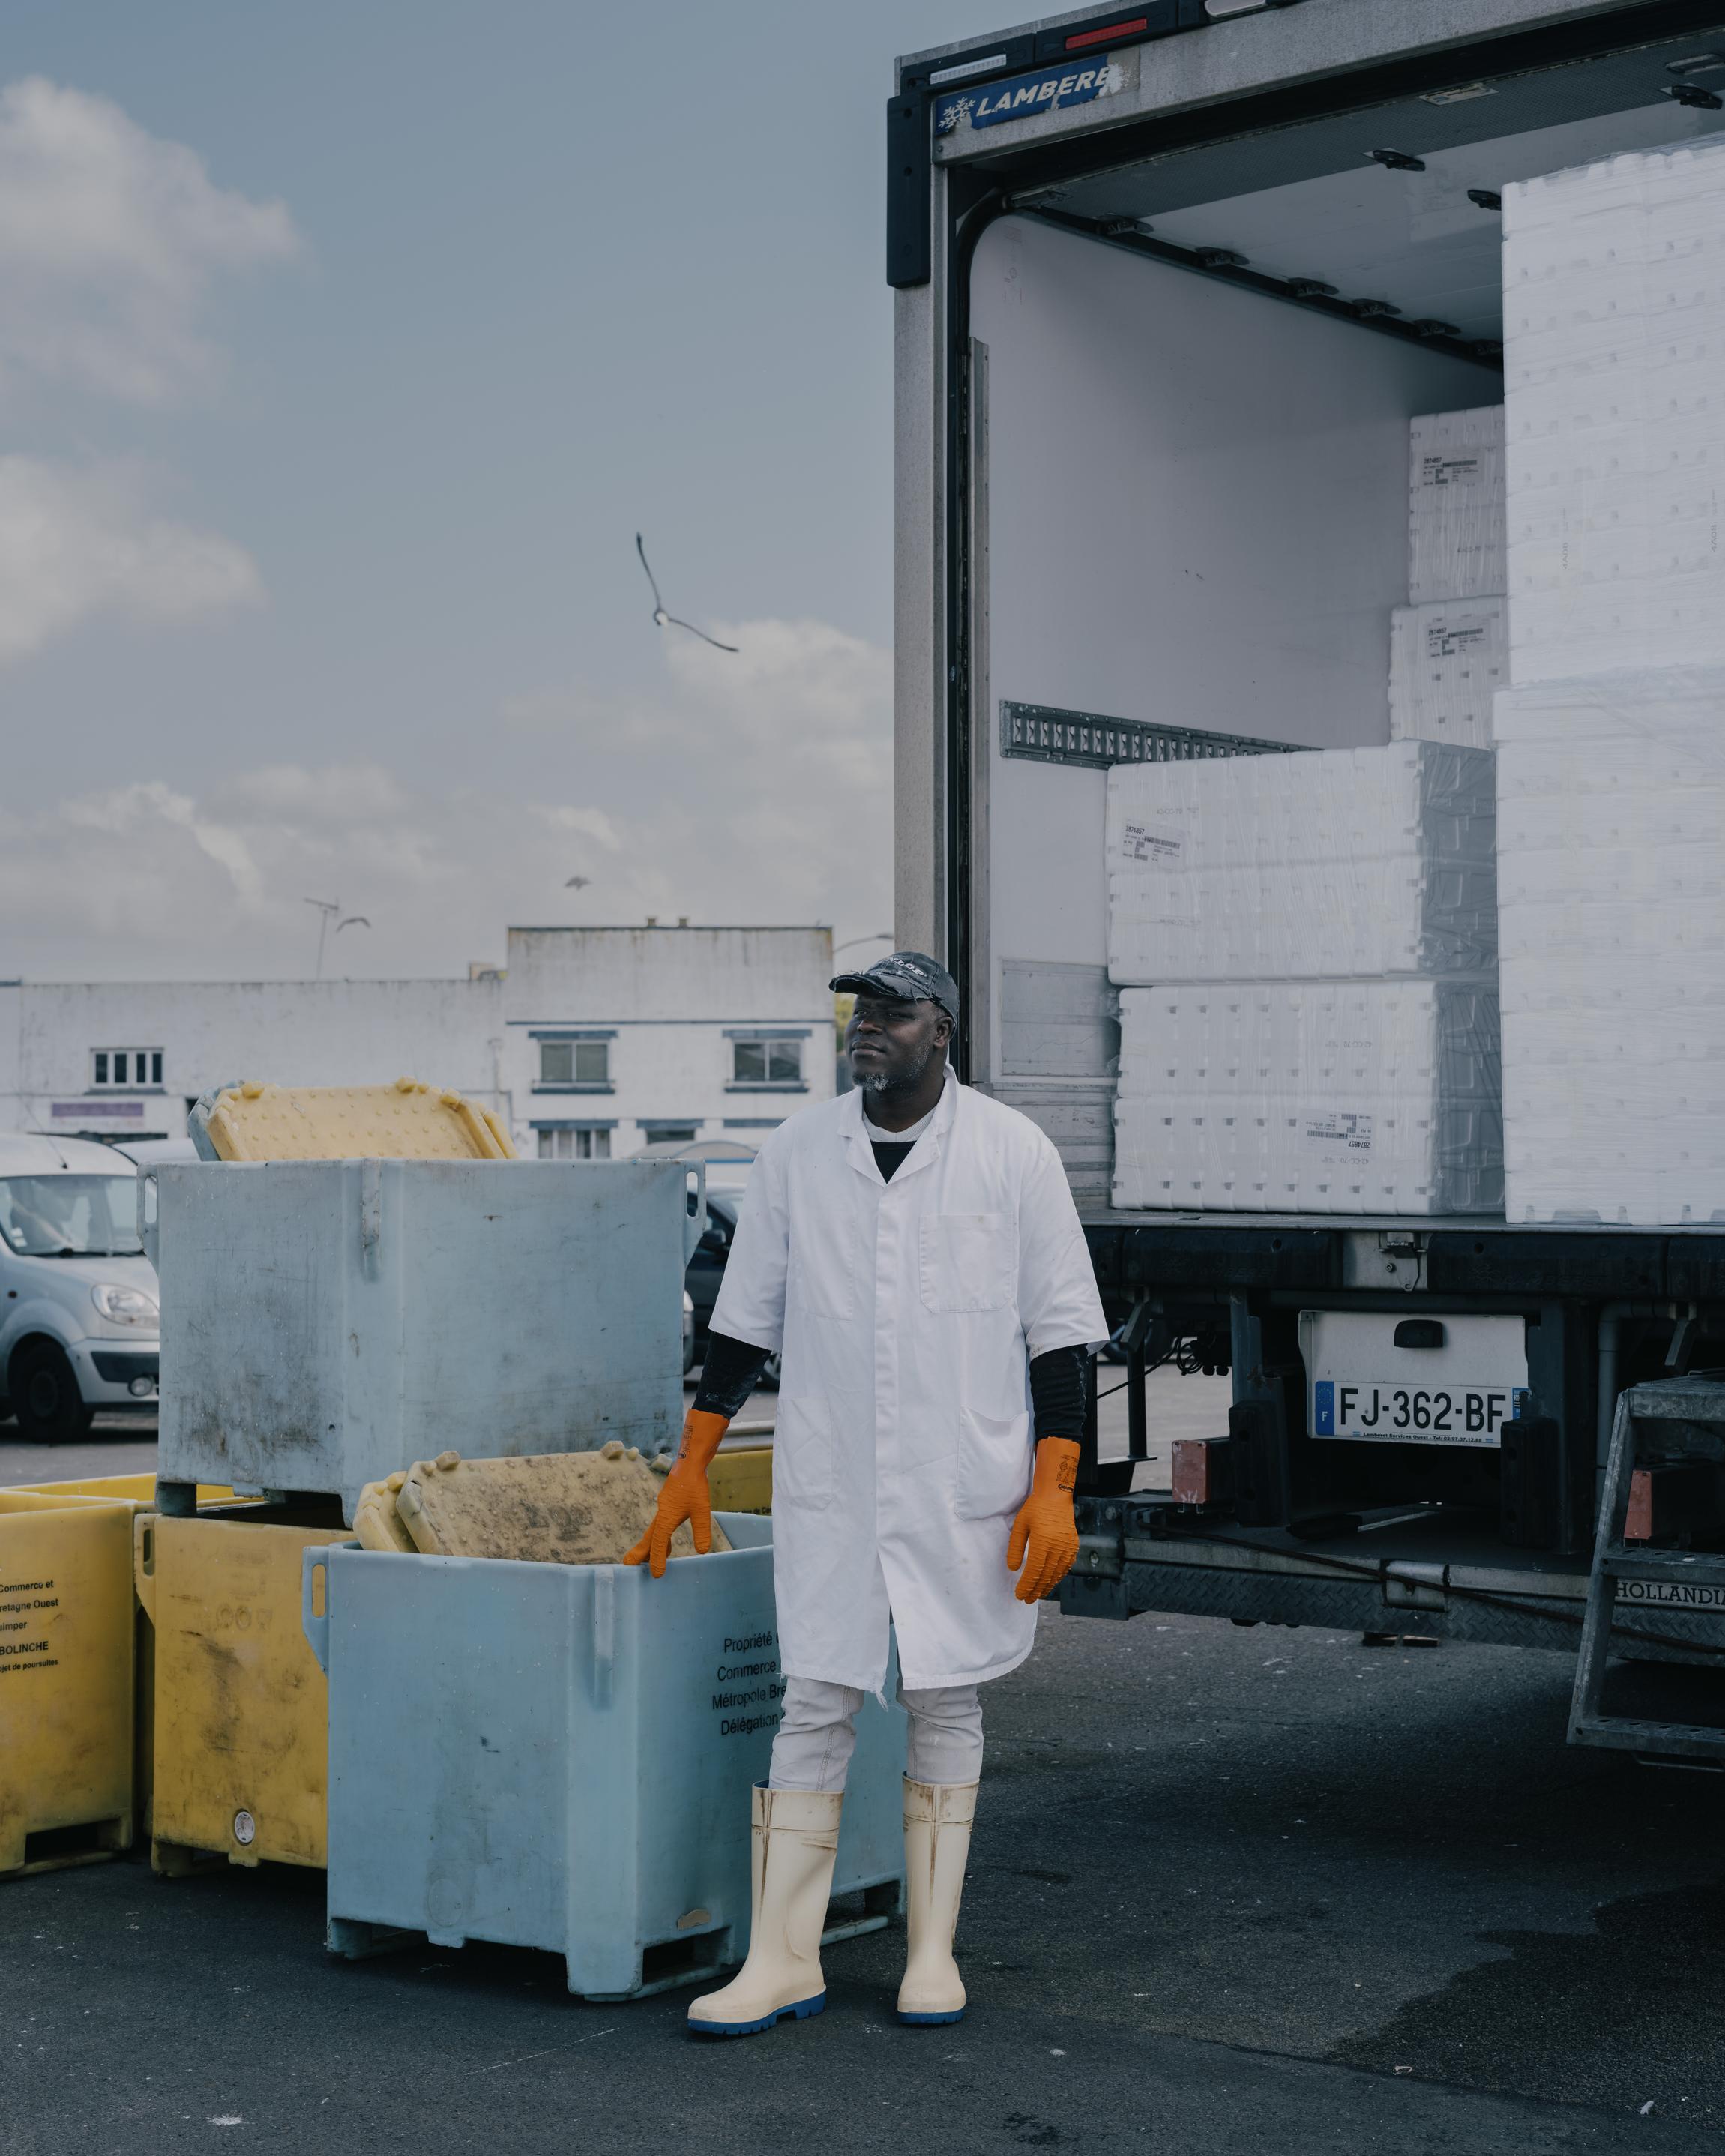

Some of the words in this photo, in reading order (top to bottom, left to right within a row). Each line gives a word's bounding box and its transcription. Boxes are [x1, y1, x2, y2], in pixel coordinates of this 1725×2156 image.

[1322, 1411, 1328, 1422] F
[1340, 1388, 1506, 1433] FJ-362-BF
[46, 1580, 54, 1588] et
[34, 1598, 58, 1608] Ouest
[0, 1641, 49, 1656] BOLINCHE
[724, 1631, 773, 1654] Propriété
[22, 1658, 58, 1671] poursuites
[717, 1660, 777, 1681] Commerce
[712, 1688, 766, 1710] Métropole
[721, 1713, 778, 1736] Délégation
